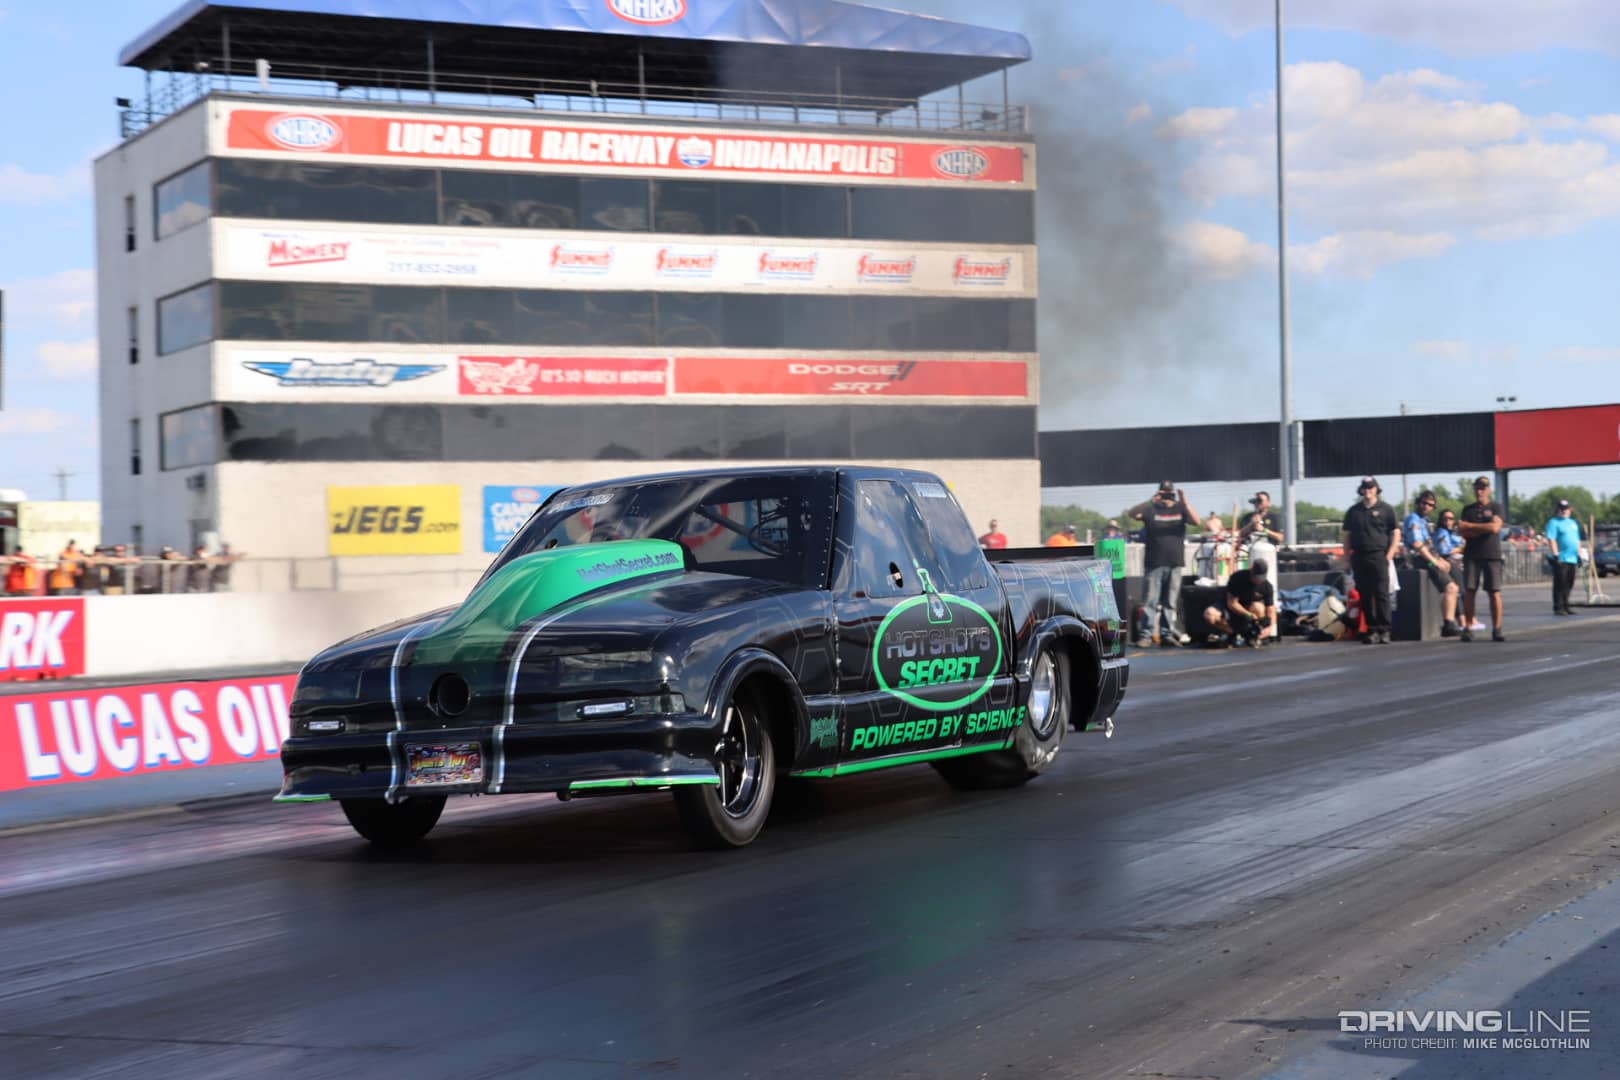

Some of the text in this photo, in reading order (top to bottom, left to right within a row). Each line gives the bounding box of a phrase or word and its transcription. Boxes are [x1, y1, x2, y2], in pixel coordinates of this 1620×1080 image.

[387, 121, 484, 156] LUCAS
[488, 128, 534, 159] OIL
[540, 130, 676, 166] RACEWAY
[713, 138, 897, 175] INDIANAPOLIS
[788, 363, 900, 375] DODGE
[829, 381, 891, 394] SRT
[898, 655, 981, 689] SECRET
[15, 688, 211, 781] LUCAS
[851, 718, 937, 751] POWERED
[939, 714, 963, 738] BY
[966, 705, 1026, 735] SCIENCE
